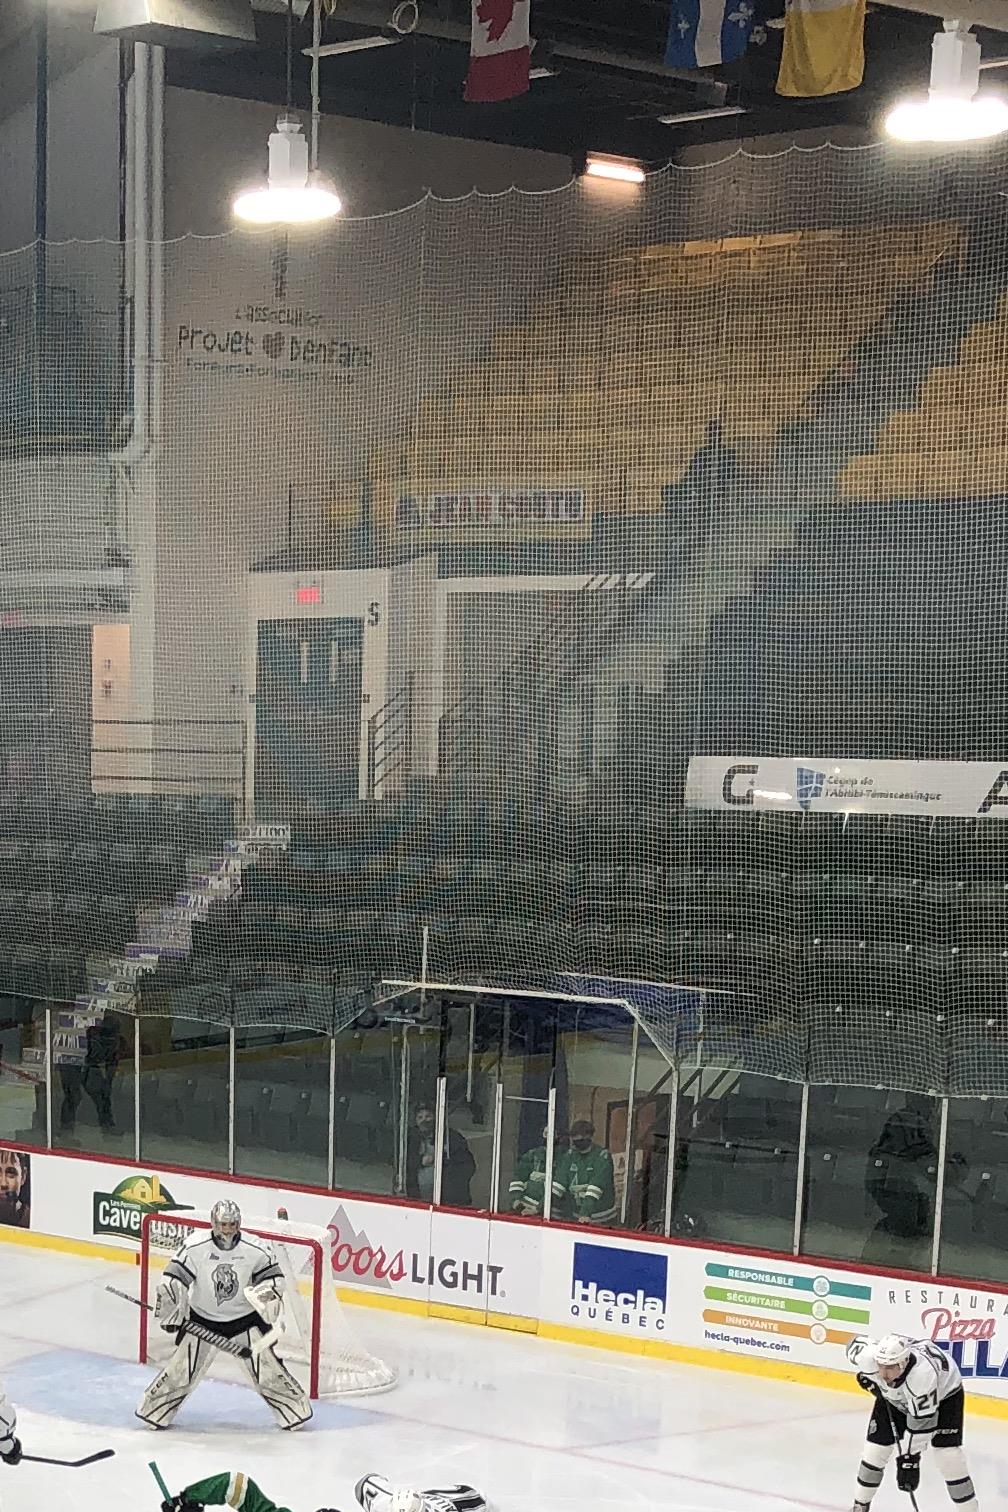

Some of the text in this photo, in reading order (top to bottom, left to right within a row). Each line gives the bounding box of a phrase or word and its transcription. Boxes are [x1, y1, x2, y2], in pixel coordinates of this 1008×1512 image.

[327, 1224, 504, 1297] Coors LIGHT
[727, 1268, 794, 1287] RESPONSABLE
[573, 1280, 665, 1313] Hecla
[726, 1290, 786, 1310] SÉCURITAIRE
[570, 1304, 665, 1331] QUÉBEC
[725, 1314, 780, 1332] INNOVANTE
[921, 1308, 996, 1342] Pizza
[704, 1329, 790, 1353] hecla-quebec.com
